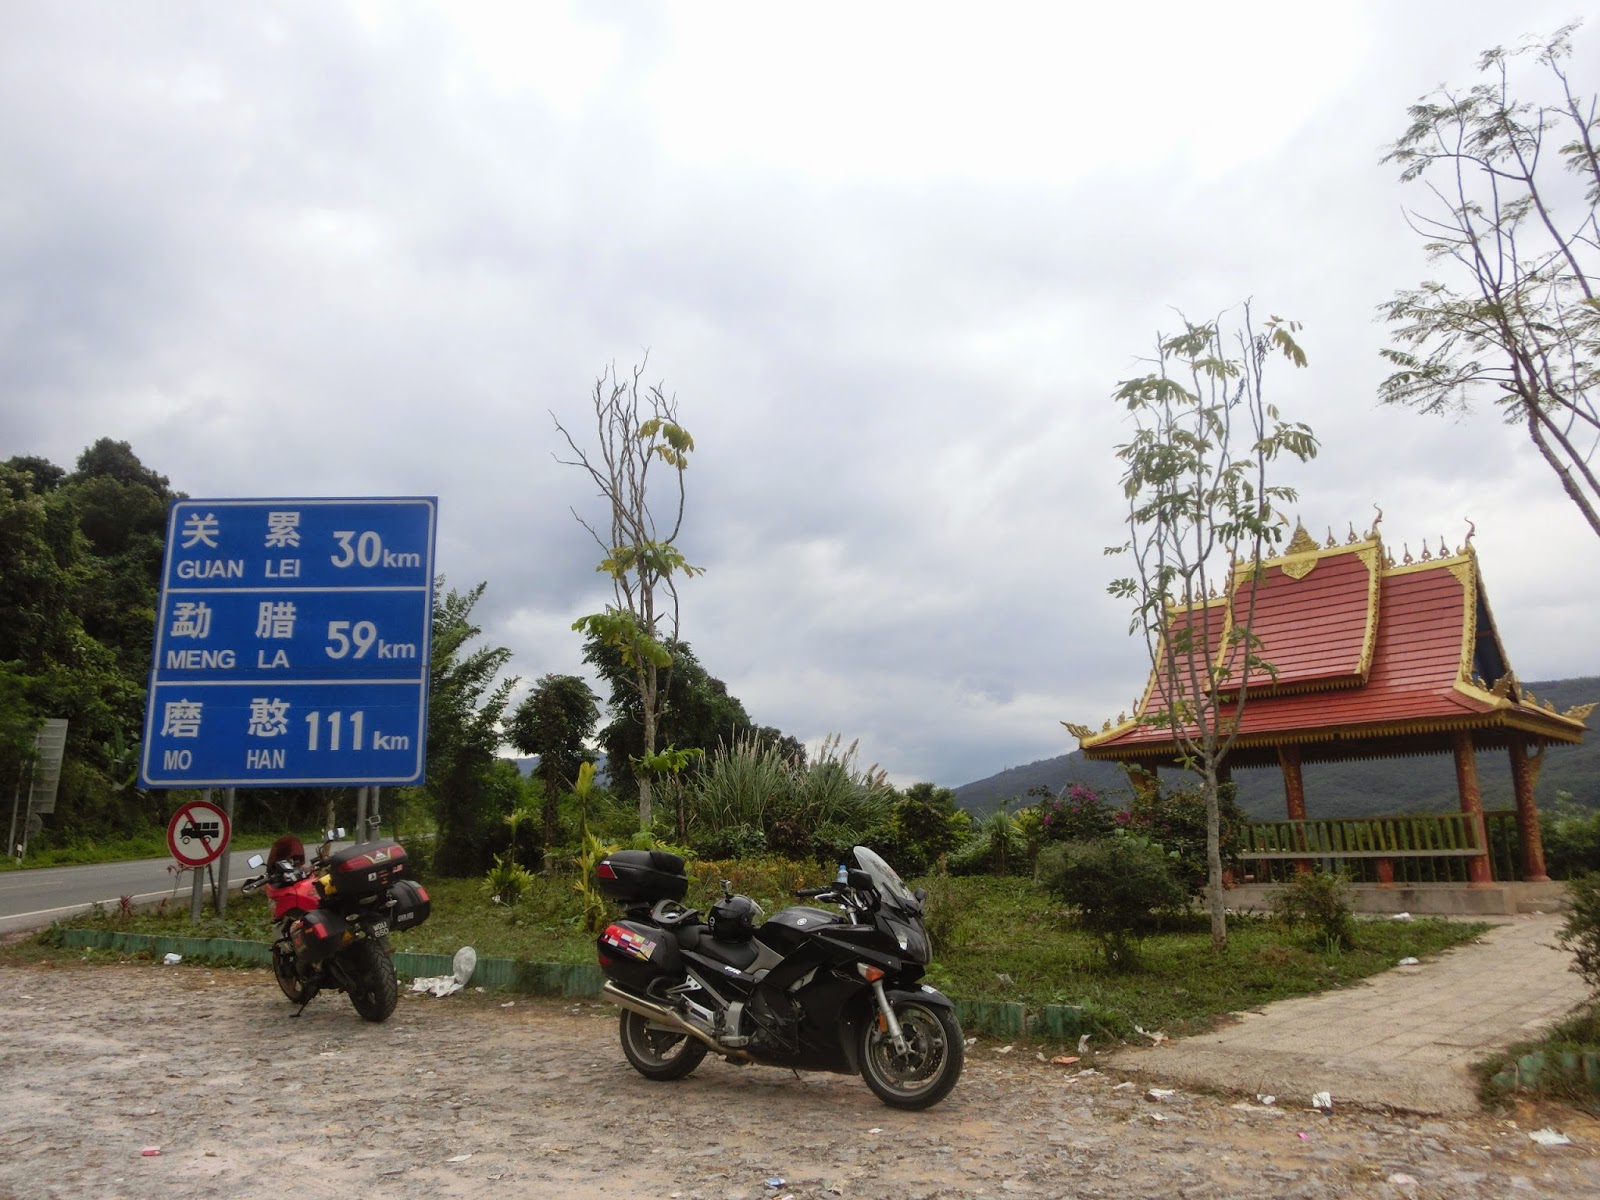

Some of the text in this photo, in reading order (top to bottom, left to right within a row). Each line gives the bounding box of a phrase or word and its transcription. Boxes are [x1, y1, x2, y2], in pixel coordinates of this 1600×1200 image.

[181, 511, 301, 549] 关 累
[176, 558, 301, 579] GUAN LEI
[166, 649, 290, 669] MENG LA
[163, 749, 285, 770] MO HAN
